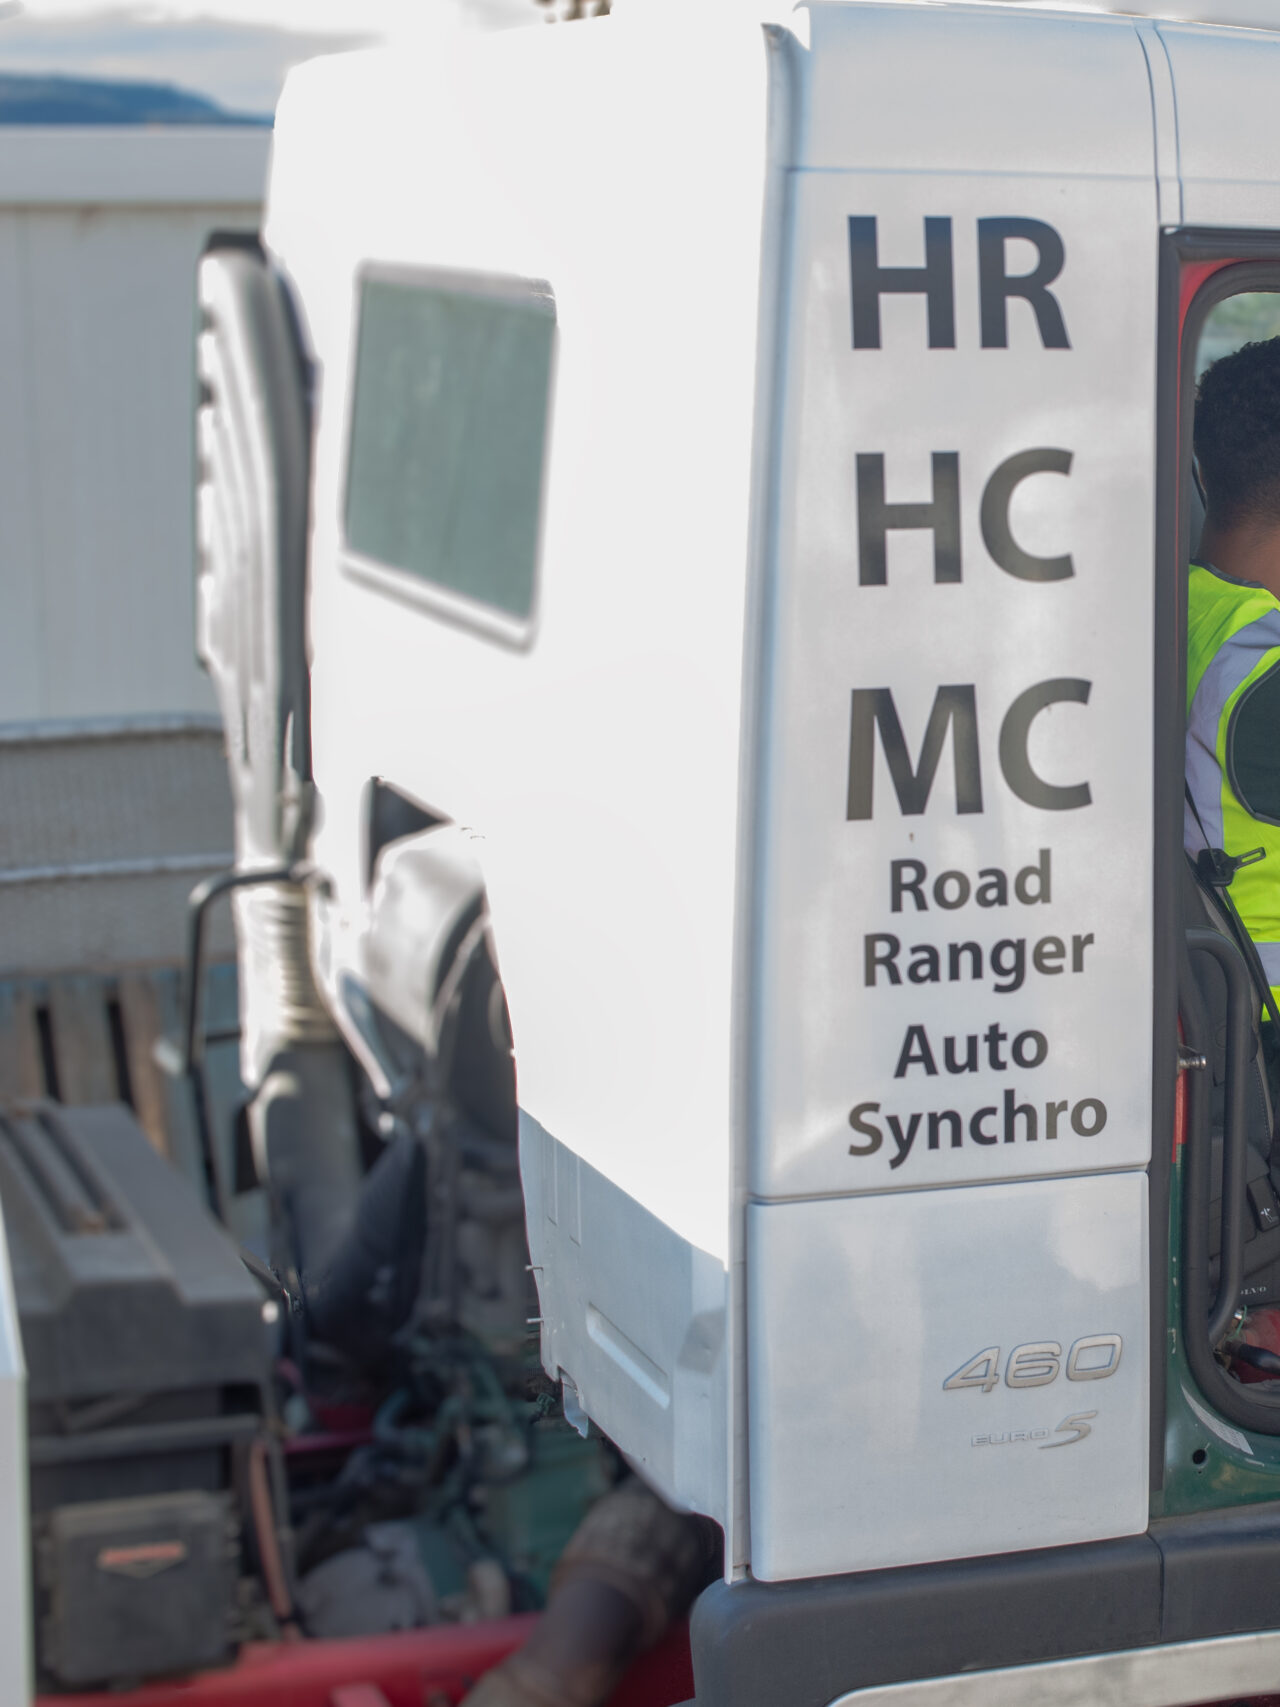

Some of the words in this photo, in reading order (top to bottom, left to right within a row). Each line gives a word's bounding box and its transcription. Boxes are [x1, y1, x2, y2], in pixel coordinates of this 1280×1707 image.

[847, 216, 1071, 350] HR
[856, 447, 1075, 586] HC
[846, 677, 1092, 820] MC
[890, 848, 1051, 913] Road
[864, 932, 1094, 993] Ranger
[894, 1022, 1048, 1078] Auto
[848, 1089, 1108, 1170] Synchro
[943, 1333, 1122, 1393] 460
[970, 1427, 1049, 1447] EURO
